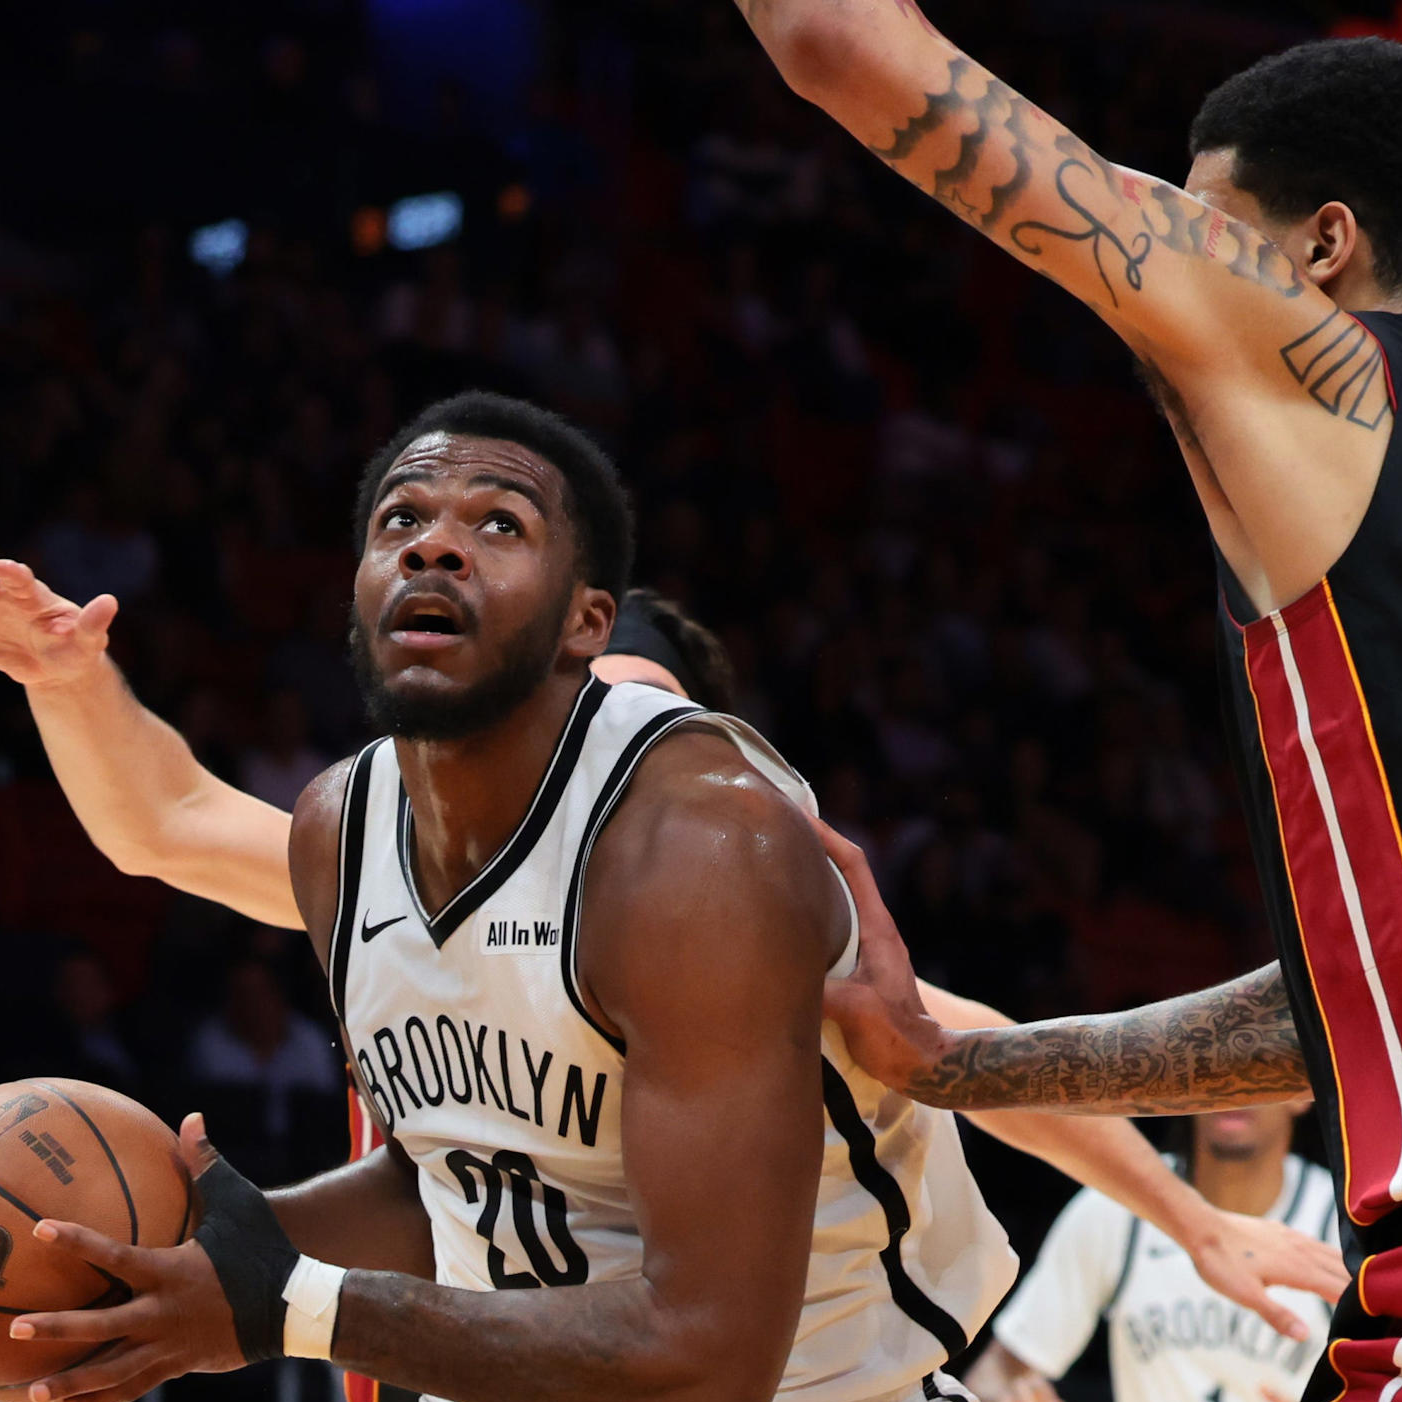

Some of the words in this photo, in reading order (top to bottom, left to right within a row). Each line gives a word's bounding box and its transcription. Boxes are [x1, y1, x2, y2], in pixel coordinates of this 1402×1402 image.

[486, 921, 507, 947] All
[512, 920, 529, 946] In
[358, 1014, 607, 1147] BROOKLYN
[445, 1149, 589, 1291] 20
